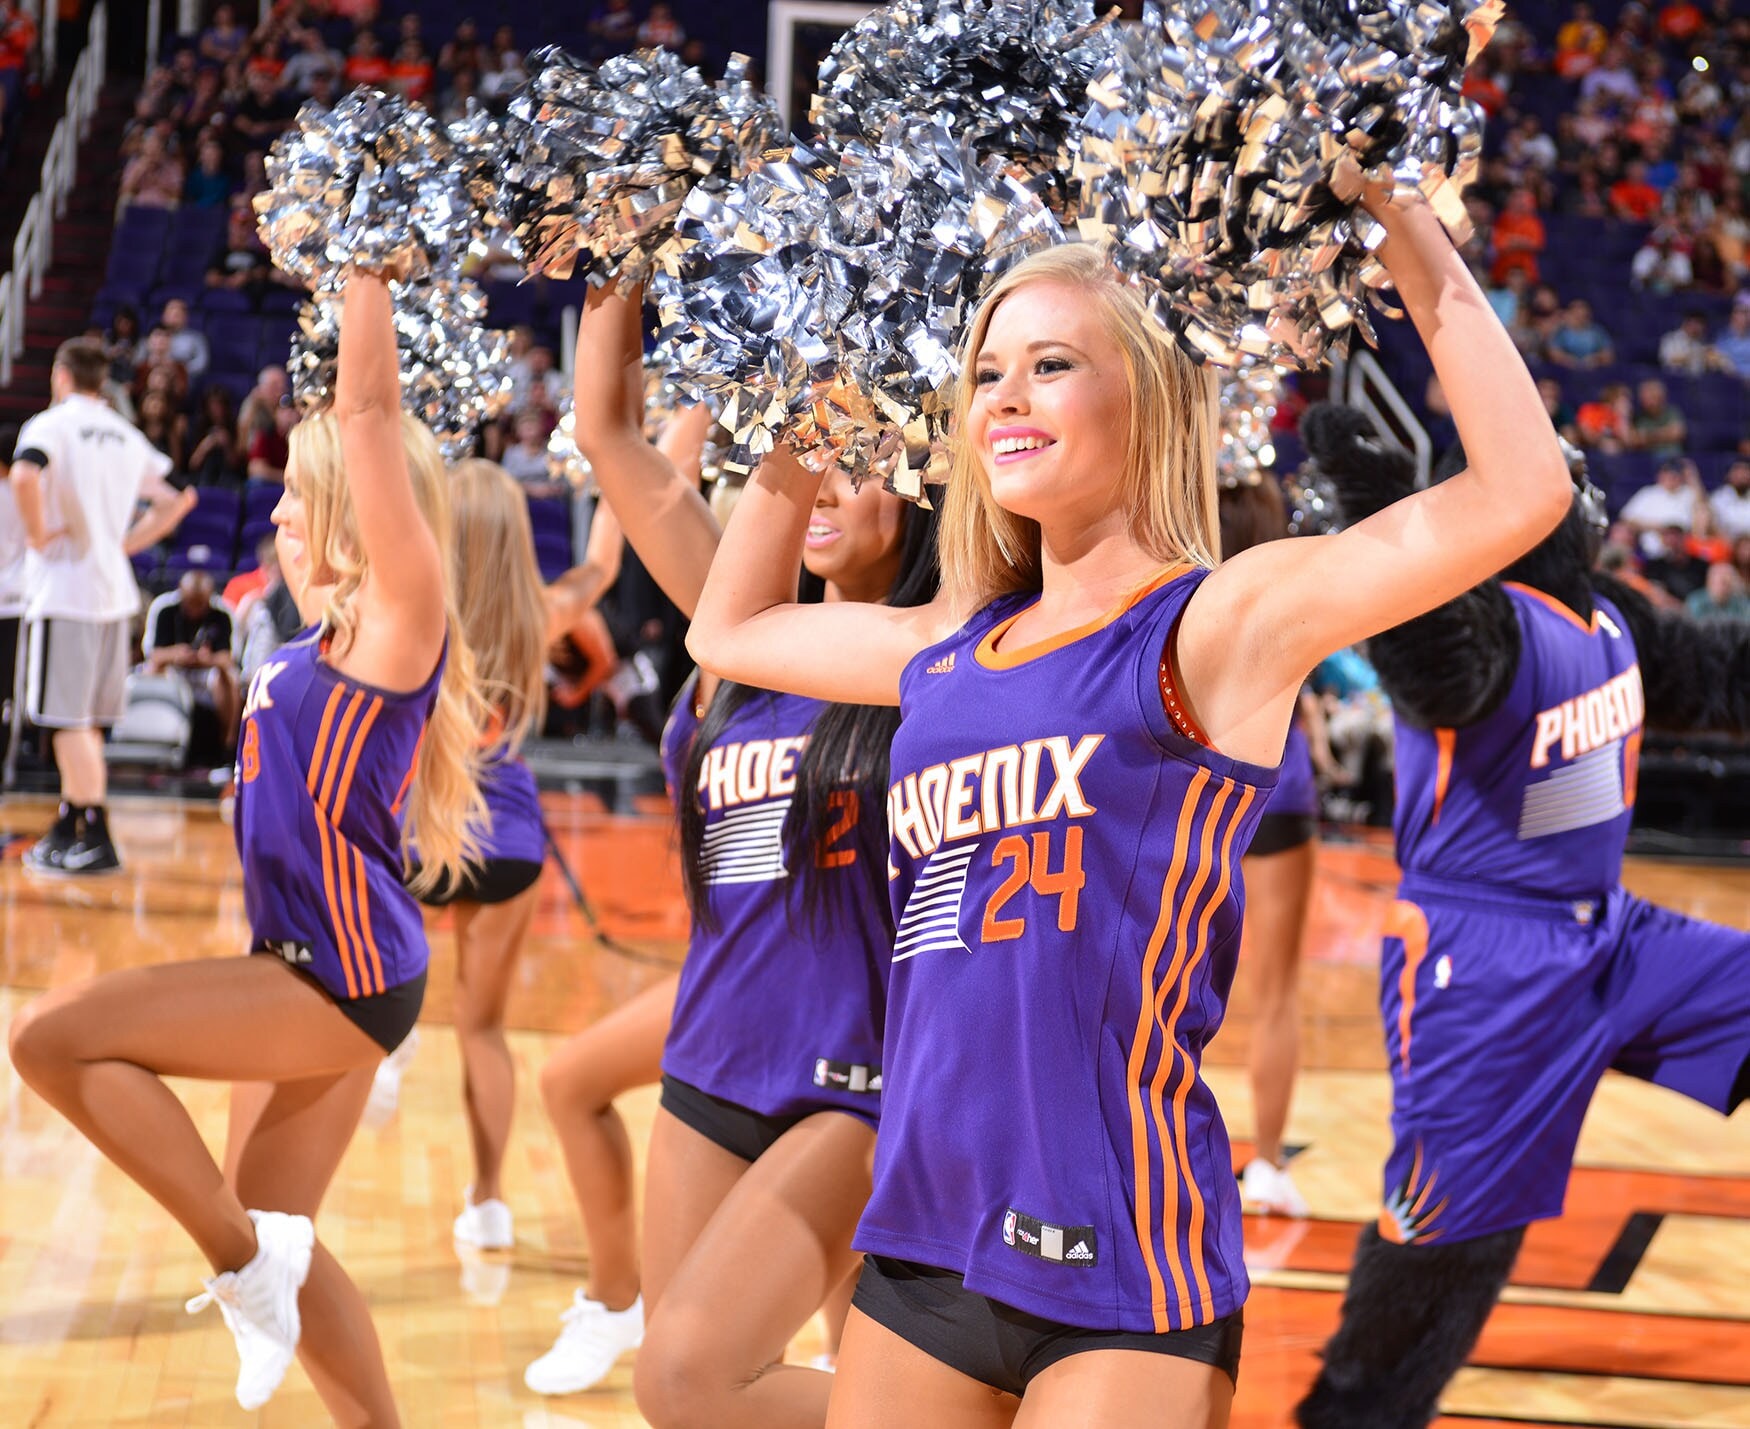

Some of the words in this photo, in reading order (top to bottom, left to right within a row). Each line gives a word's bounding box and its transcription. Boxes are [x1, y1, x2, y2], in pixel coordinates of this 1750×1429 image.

[1530, 663, 1645, 769] PHOEN
[980, 825, 1086, 943] 24
[1065, 1252, 1094, 1260] adidas
